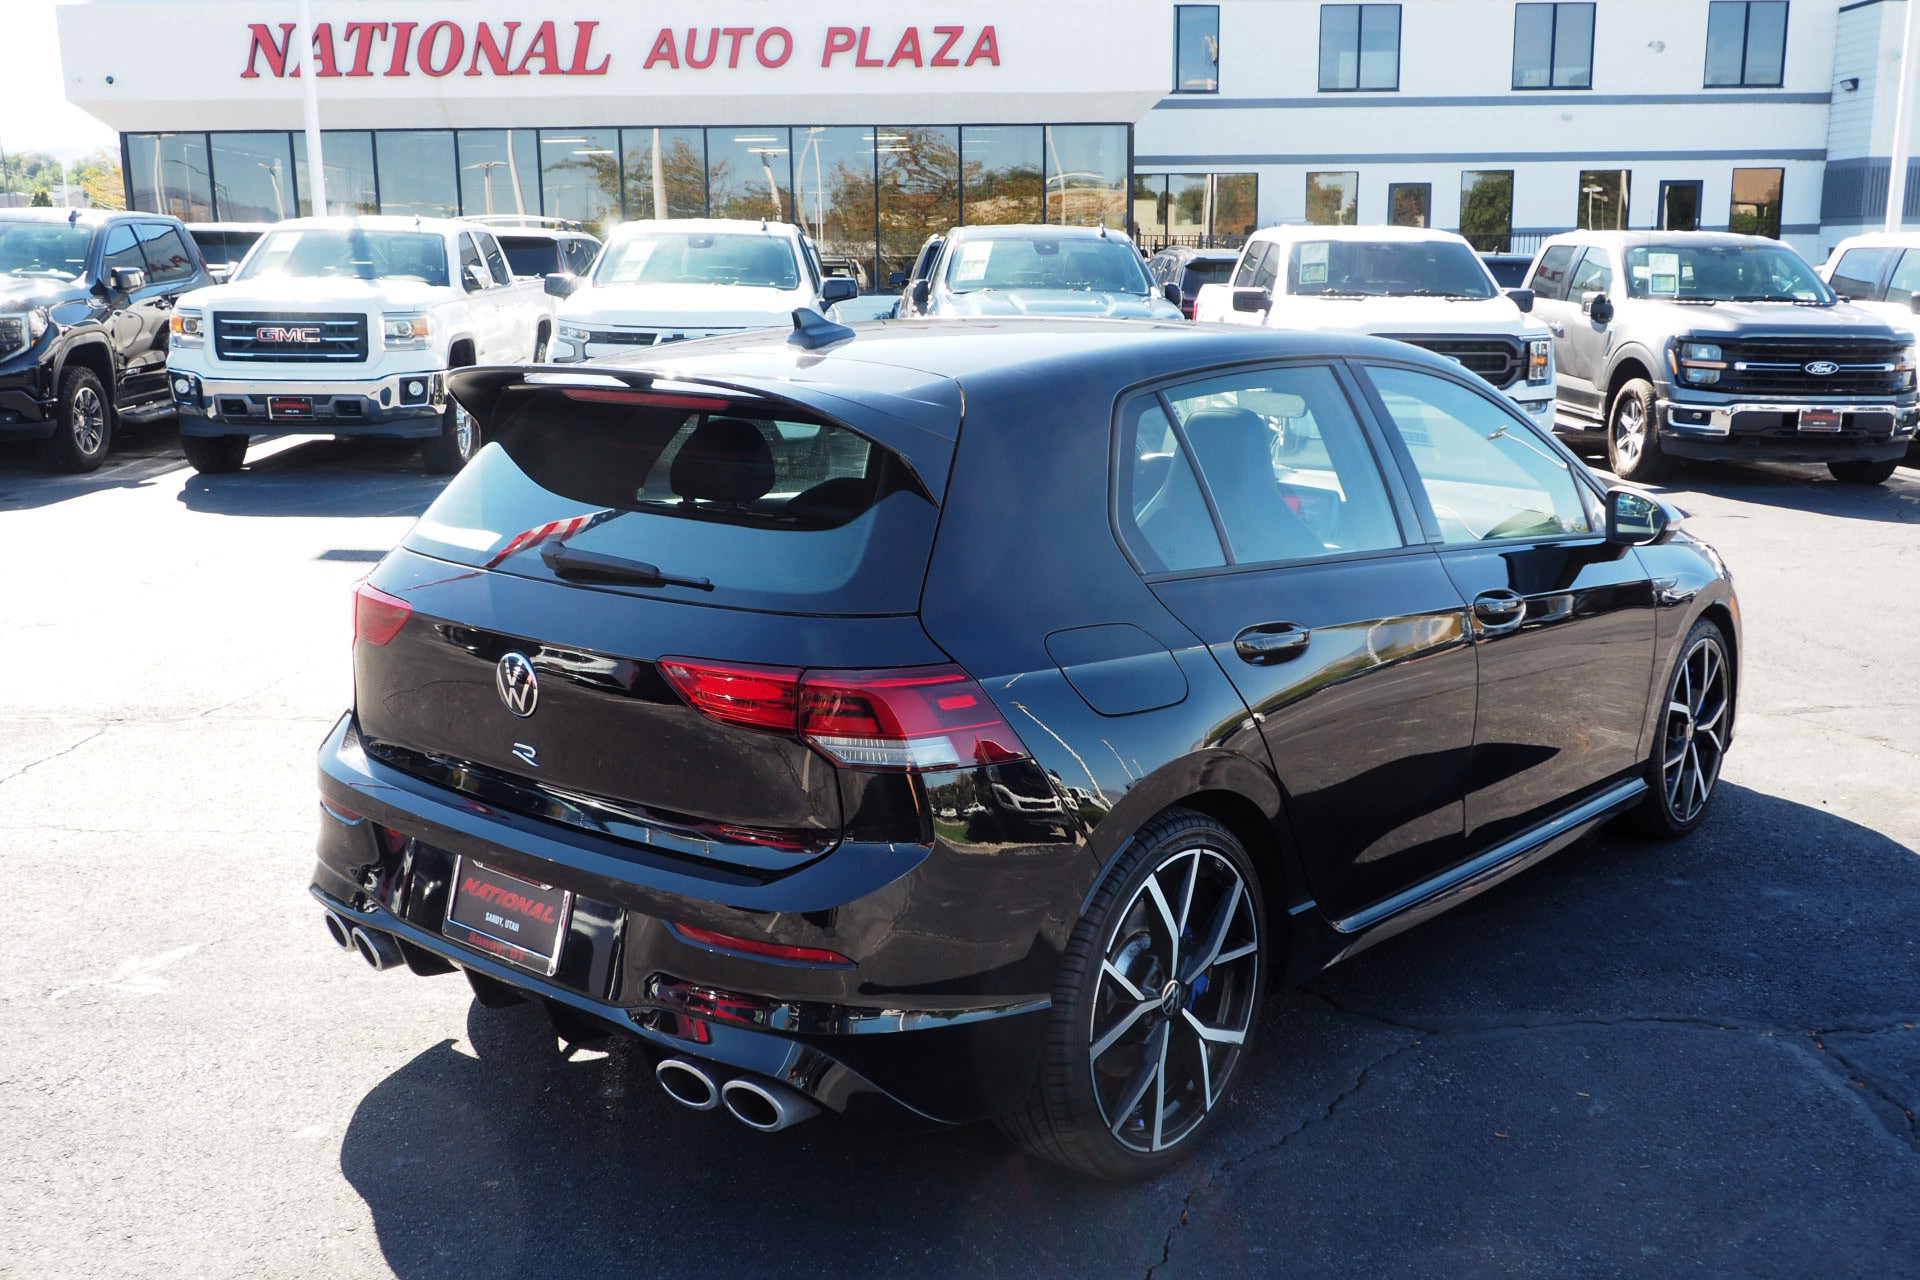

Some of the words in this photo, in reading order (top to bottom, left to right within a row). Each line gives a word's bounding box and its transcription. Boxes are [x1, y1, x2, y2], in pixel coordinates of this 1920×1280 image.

[240, 21, 611, 79] NATIONAL
[643, 27, 794, 69] AUTO
[821, 25, 1001, 68] PLAZA
[257, 327, 320, 342] GMC
[462, 877, 555, 923] NATIONAL
[485, 912, 504, 928] SANDY,
[504, 919, 520, 933] UTAH
